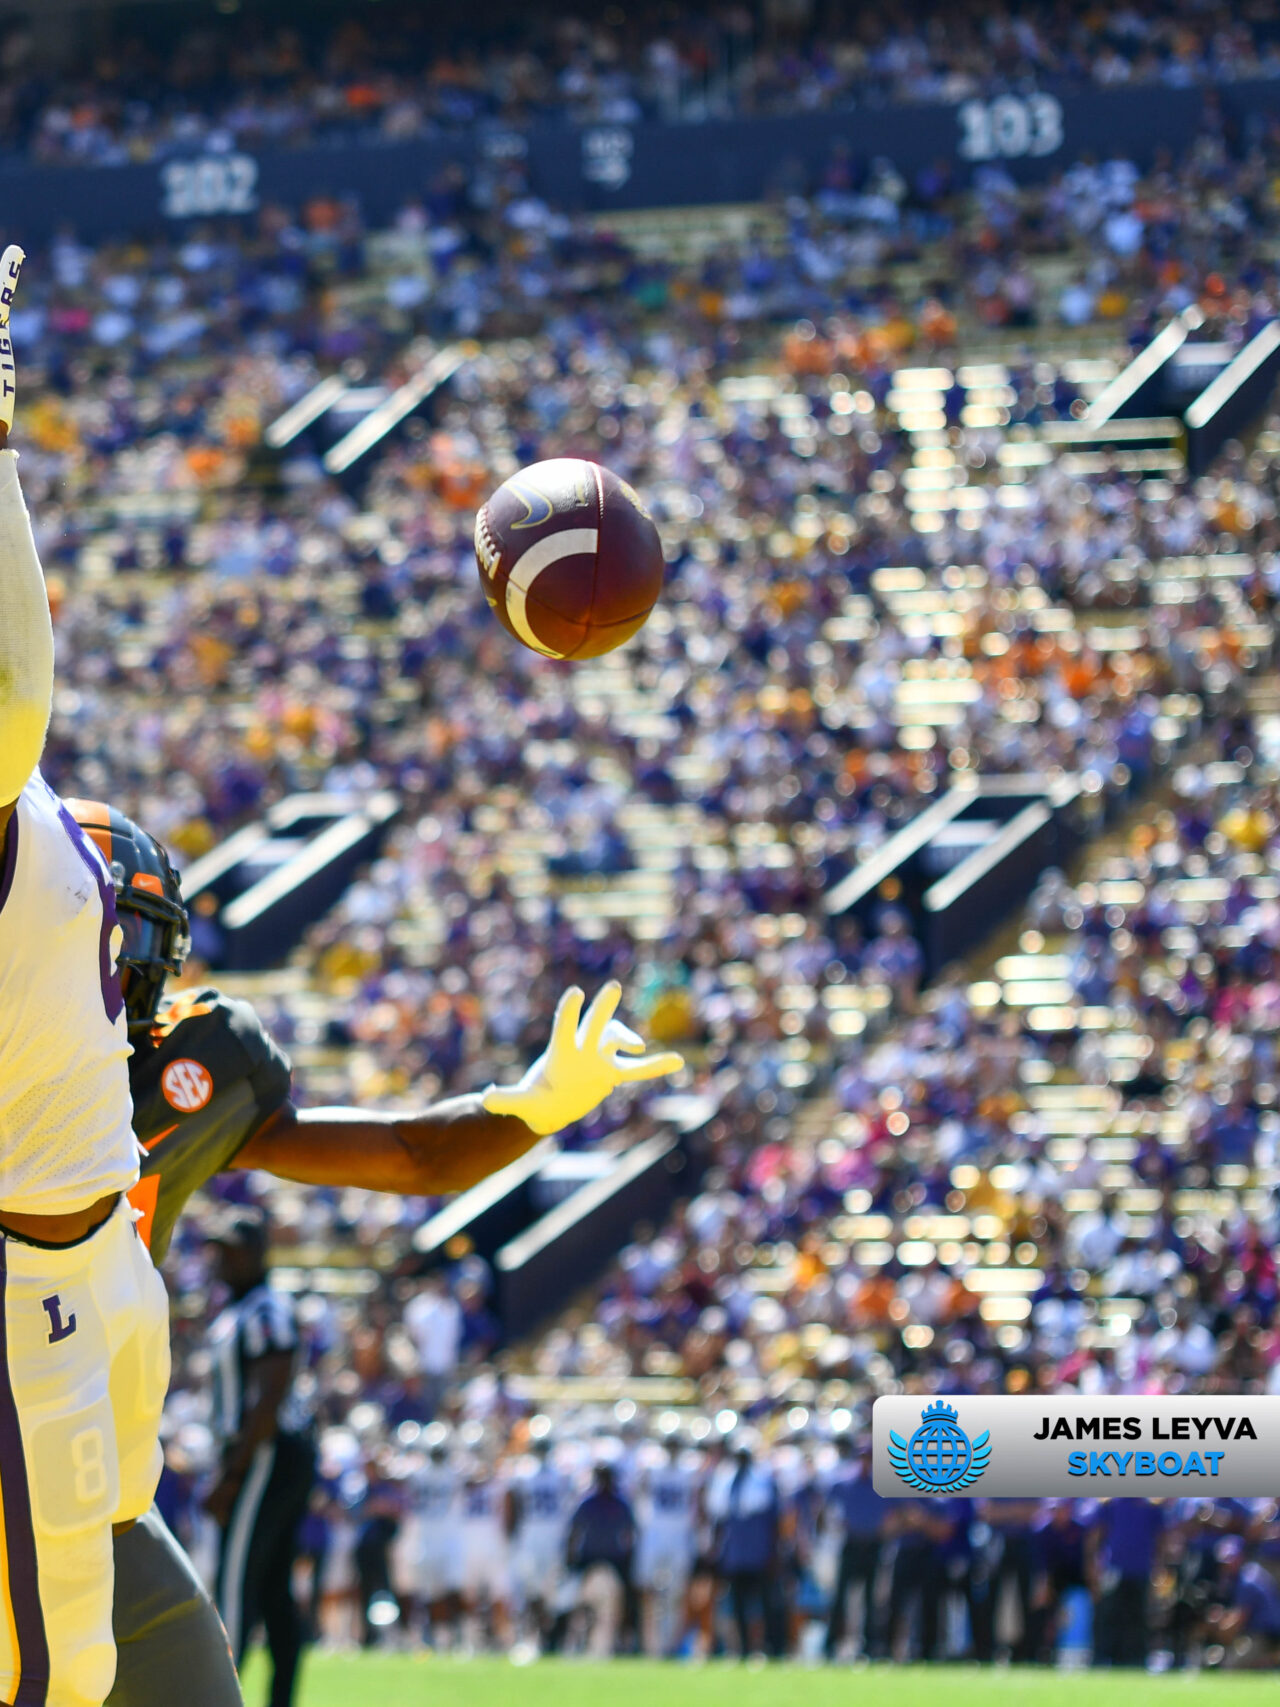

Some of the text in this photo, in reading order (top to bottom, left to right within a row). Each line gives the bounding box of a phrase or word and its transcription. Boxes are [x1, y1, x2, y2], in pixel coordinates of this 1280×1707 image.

[958, 92, 1063, 161] 103
[165, 1061, 210, 1109] SEC
[42, 1294, 77, 1345] L
[71, 1425, 107, 1502] 8
